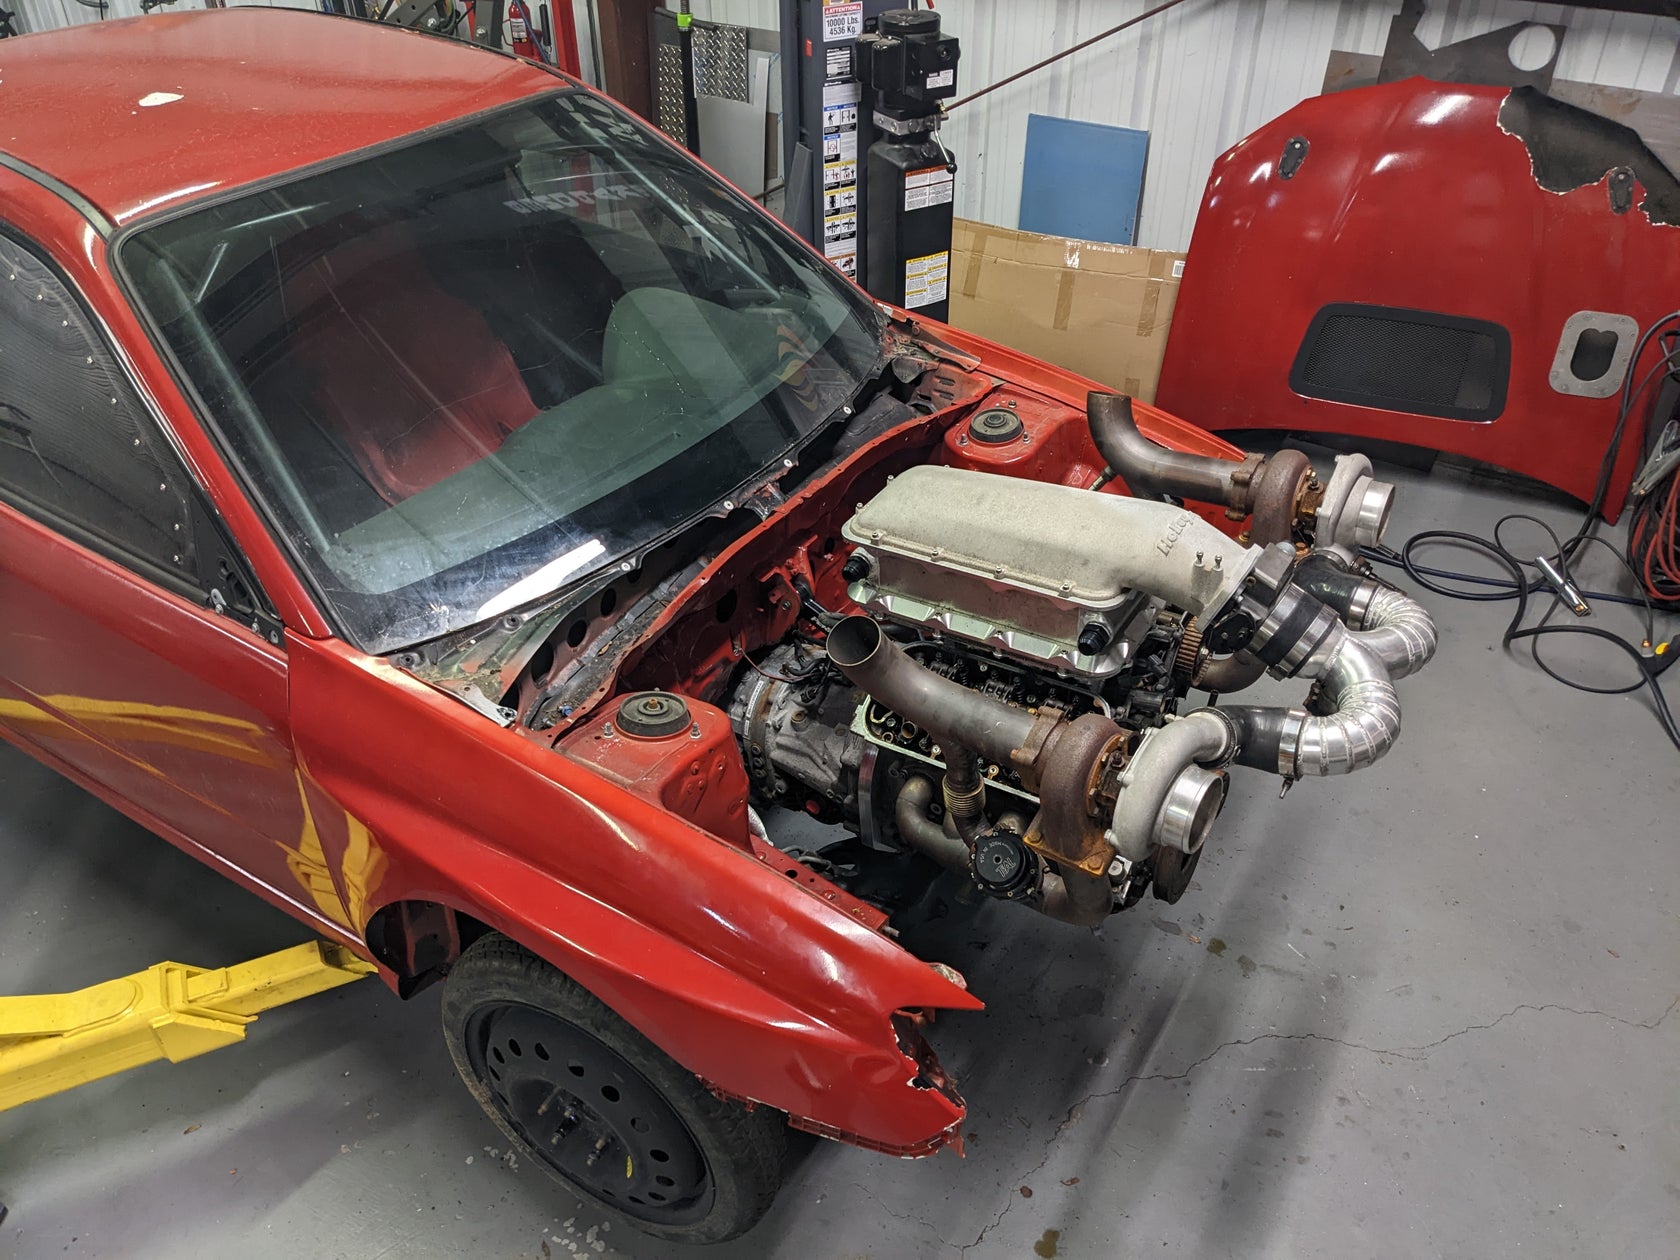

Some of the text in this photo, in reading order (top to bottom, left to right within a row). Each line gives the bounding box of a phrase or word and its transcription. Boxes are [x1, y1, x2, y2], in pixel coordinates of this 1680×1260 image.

[826, 16, 859, 27] 10000 Lbs.
[829, 27, 846, 36] 4536
